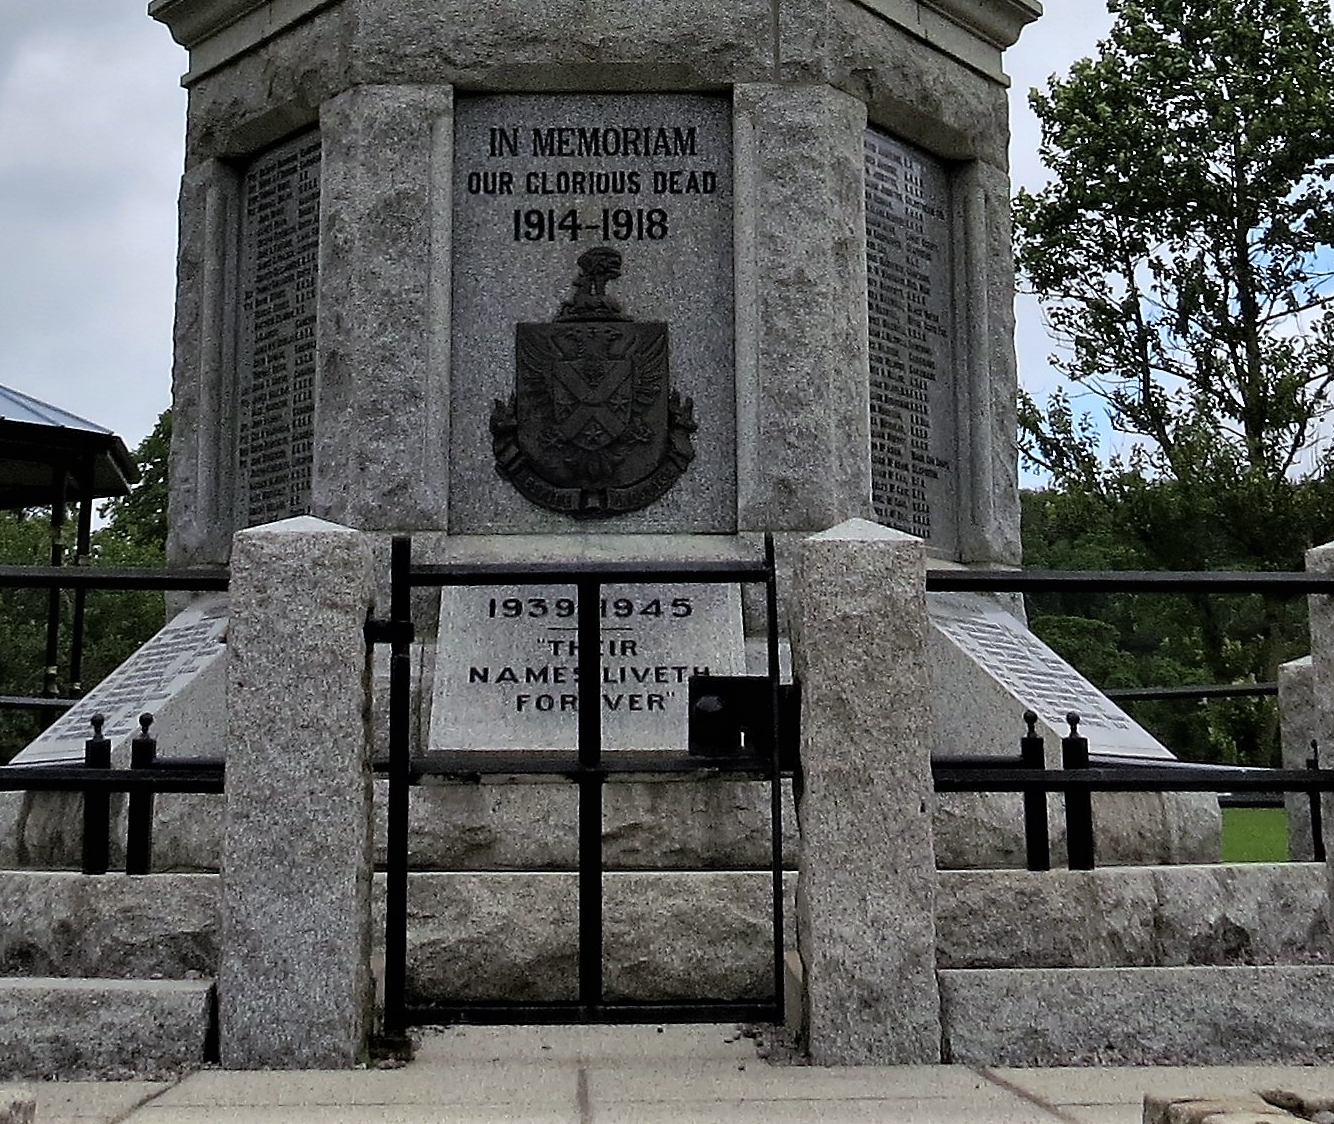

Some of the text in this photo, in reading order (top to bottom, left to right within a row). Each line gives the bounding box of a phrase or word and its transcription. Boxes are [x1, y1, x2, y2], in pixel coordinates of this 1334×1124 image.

[488, 127, 697, 157] IN MEMORIAM
[467, 171, 716, 195] OUR GLORIOUS DEAD
[513, 208, 668, 241] 1914-1918
[537, 638, 637, 656] "THIR
[516, 691, 675, 711] FORVER"
